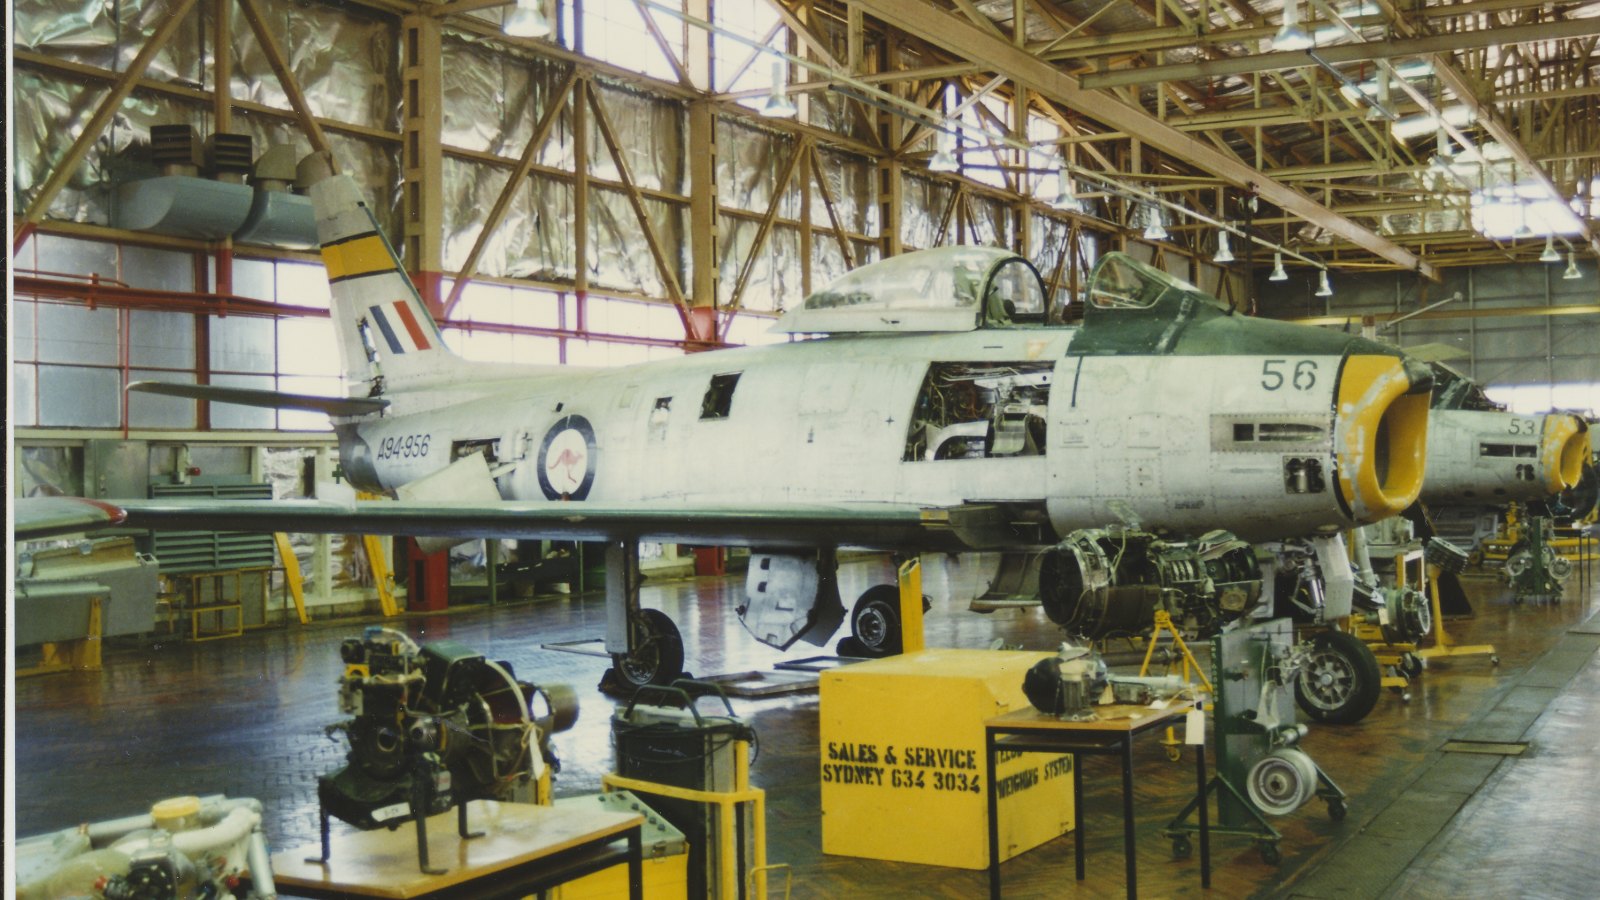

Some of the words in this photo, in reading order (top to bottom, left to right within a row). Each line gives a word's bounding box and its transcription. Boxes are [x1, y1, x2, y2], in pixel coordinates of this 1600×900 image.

[1261, 359, 1318, 391] 56
[1507, 418, 1536, 437] 53
[377, 434, 431, 461] A94-956
[828, 742, 878, 763] SALES
[884, 746, 897, 765] &
[904, 747, 977, 770] SERVICE
[1044, 754, 1073, 781] SYSTEM
[823, 764, 884, 786] SYDNEY
[891, 769, 925, 789] 634
[933, 771, 981, 794] 3034
